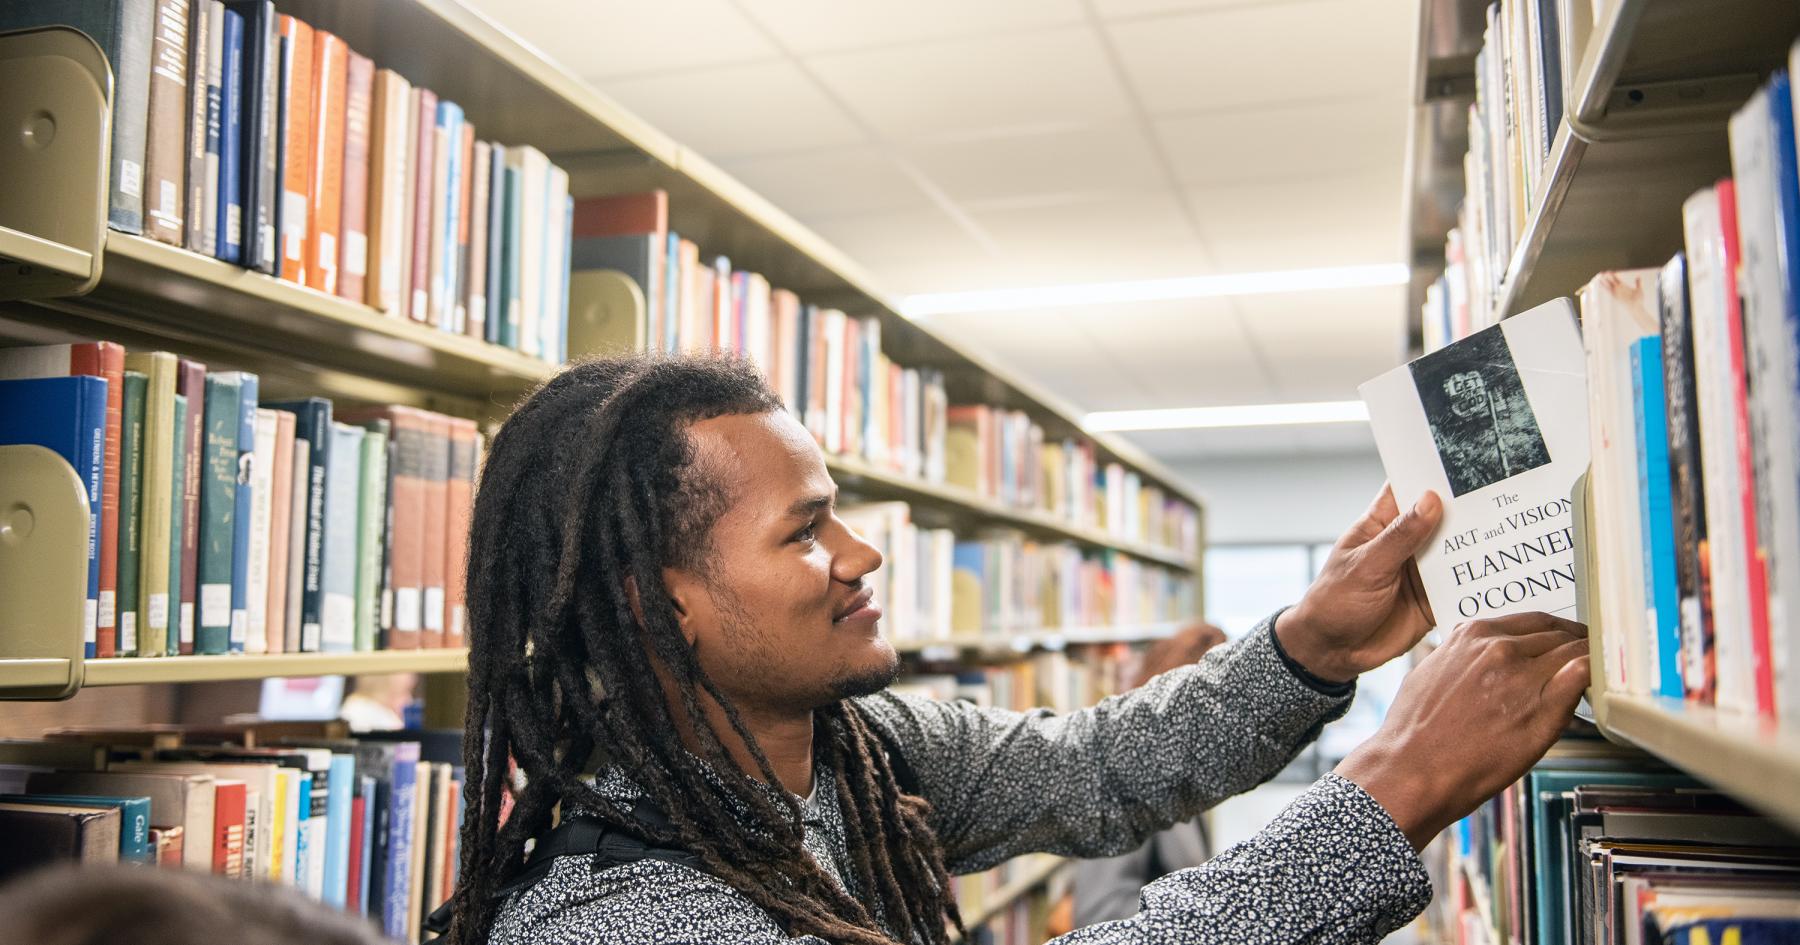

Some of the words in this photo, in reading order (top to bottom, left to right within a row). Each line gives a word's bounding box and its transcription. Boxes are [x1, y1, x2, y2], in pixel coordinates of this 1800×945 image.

[132, 422, 140, 451] Robert
[131, 452, 139, 476] Frost
[130, 494, 138, 515] New
[1492, 493, 1519, 508] The
[1444, 528, 1478, 554] ART
[1484, 522, 1505, 540] and
[134, 815, 146, 844] Gale
